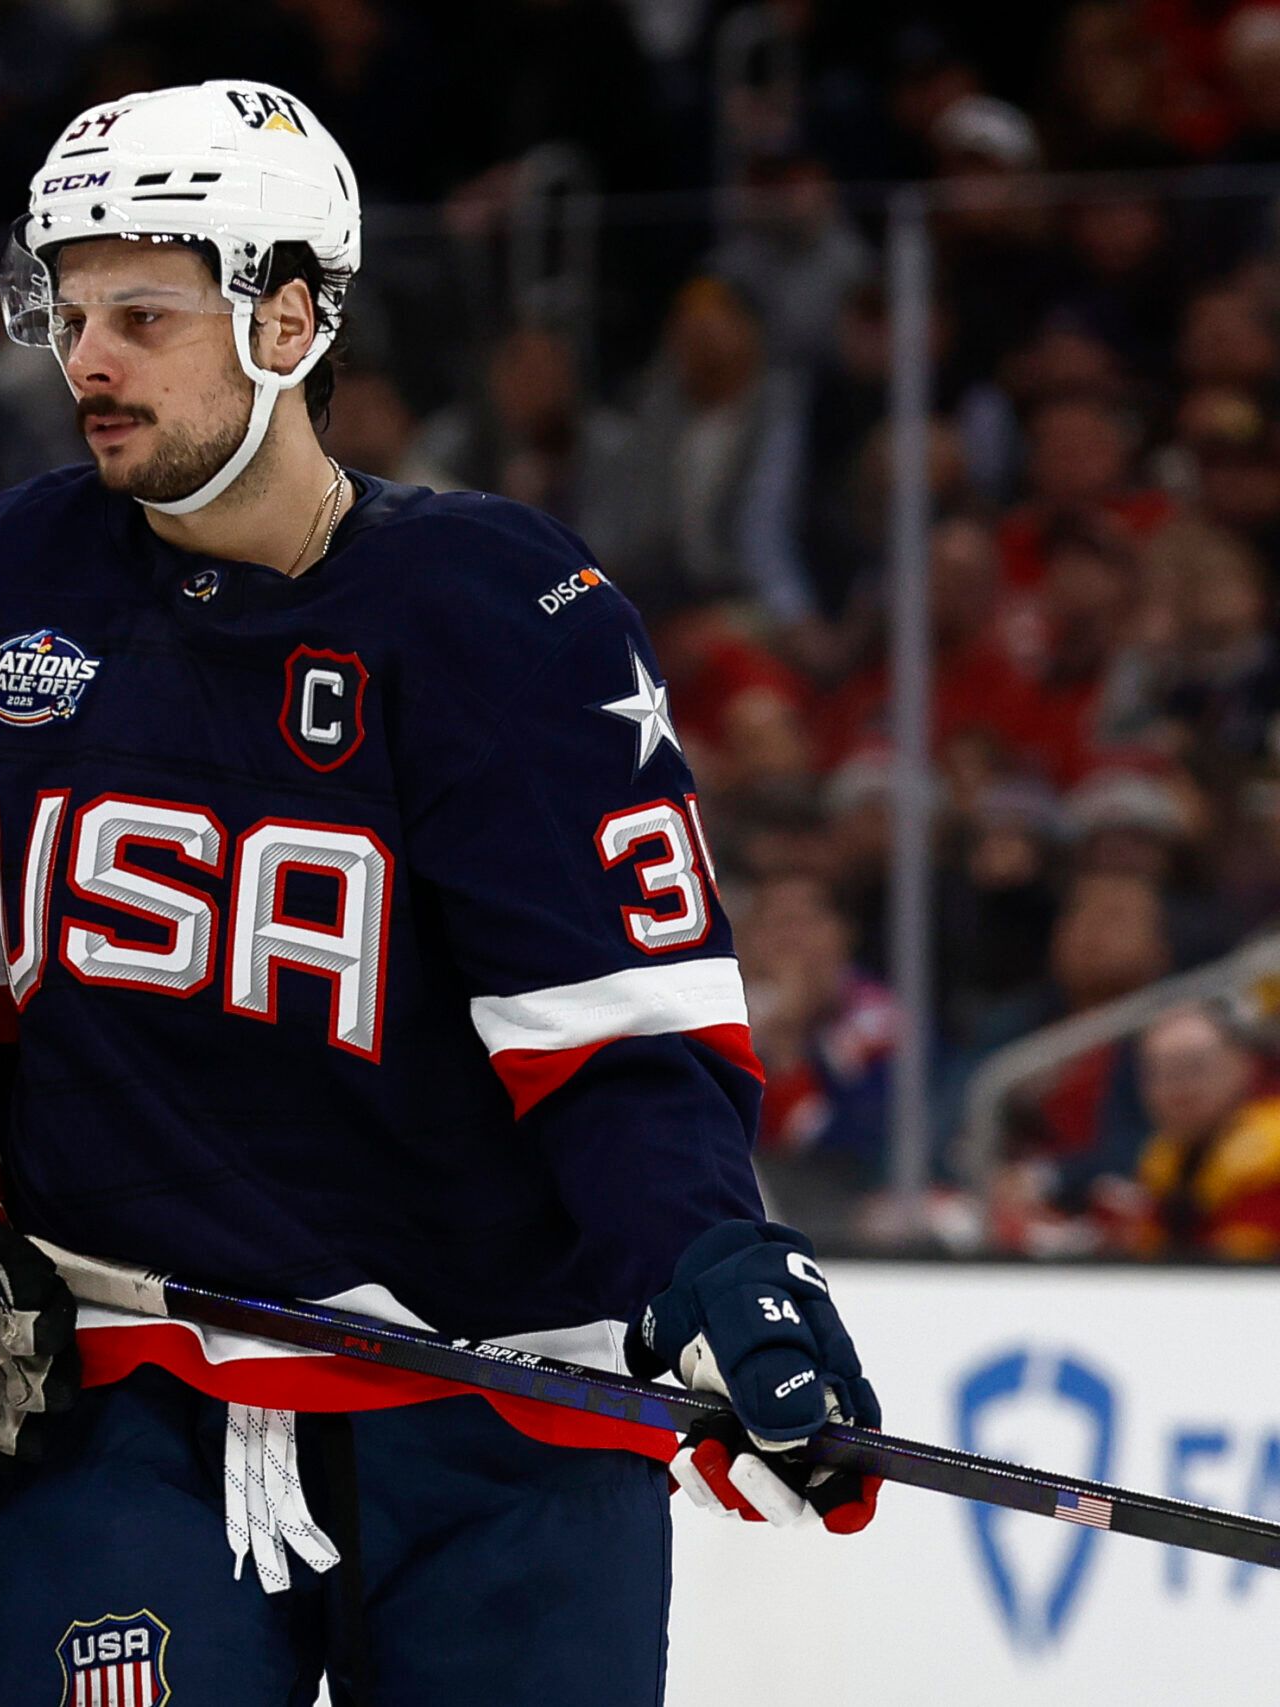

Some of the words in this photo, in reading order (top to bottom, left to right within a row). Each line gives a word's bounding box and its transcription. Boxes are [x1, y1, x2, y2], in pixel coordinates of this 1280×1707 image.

[226, 90, 308, 138] CAT
[42, 171, 111, 195] CCM
[6, 695, 34, 707] 2025
[301, 668, 344, 745] C
[592, 793, 720, 956] 3
[758, 1297, 801, 1324] 34
[474, 1343, 519, 1361] PAPI
[516, 1353, 543, 1366] 34
[775, 1369, 816, 1399] CCM
[72, 1627, 150, 1667] USA
